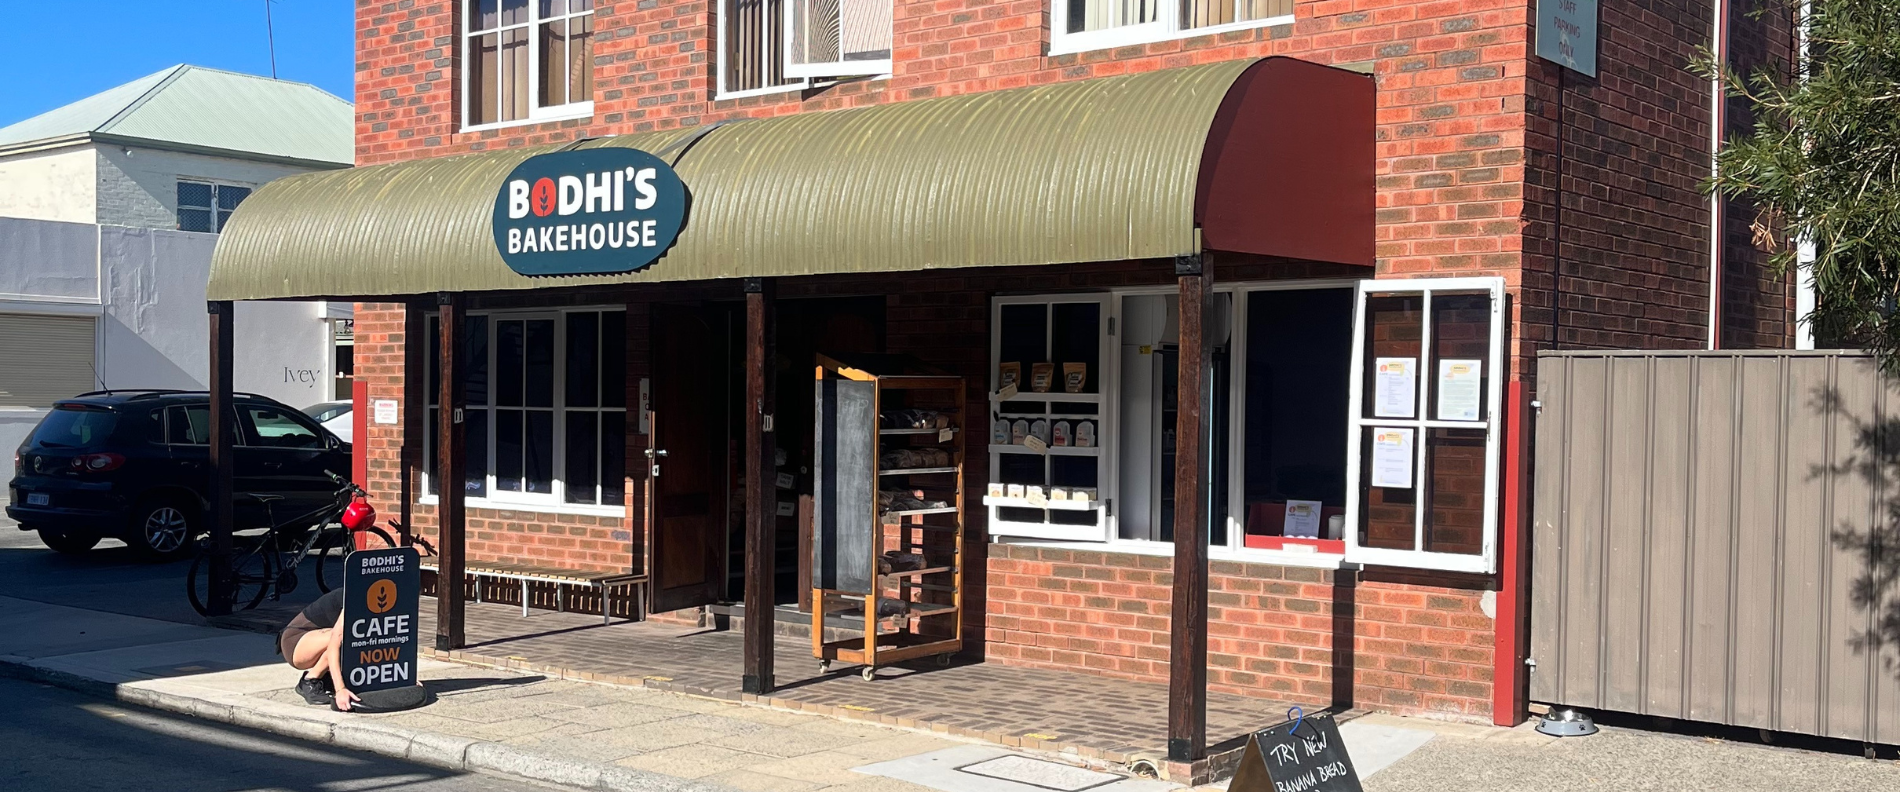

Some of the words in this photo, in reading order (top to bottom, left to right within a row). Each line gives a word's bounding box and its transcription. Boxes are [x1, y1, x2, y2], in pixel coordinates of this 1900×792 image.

[1558, 0, 1577, 15] STAFF
[1554, 16, 1580, 38] PARKING
[1559, 41, 1574, 58] ONLY
[508, 166, 658, 219] BODHI'S
[508, 220, 657, 254] BAKEHOUSE
[284, 366, 320, 388] Ivey
[361, 555, 404, 567] BODHI'S
[361, 565, 404, 575] BAKEHOUSE
[352, 614, 410, 639] CAFE
[351, 638, 377, 648] mon-fri
[378, 635, 409, 646] mornings
[360, 647, 400, 664] NOW
[350, 662, 409, 687] OPEN
[1270, 742, 1300, 766] TRY
[1302, 731, 1327, 757] NEW
[1276, 769, 1317, 792] BANANA
[1317, 761, 1347, 783] BREAD
